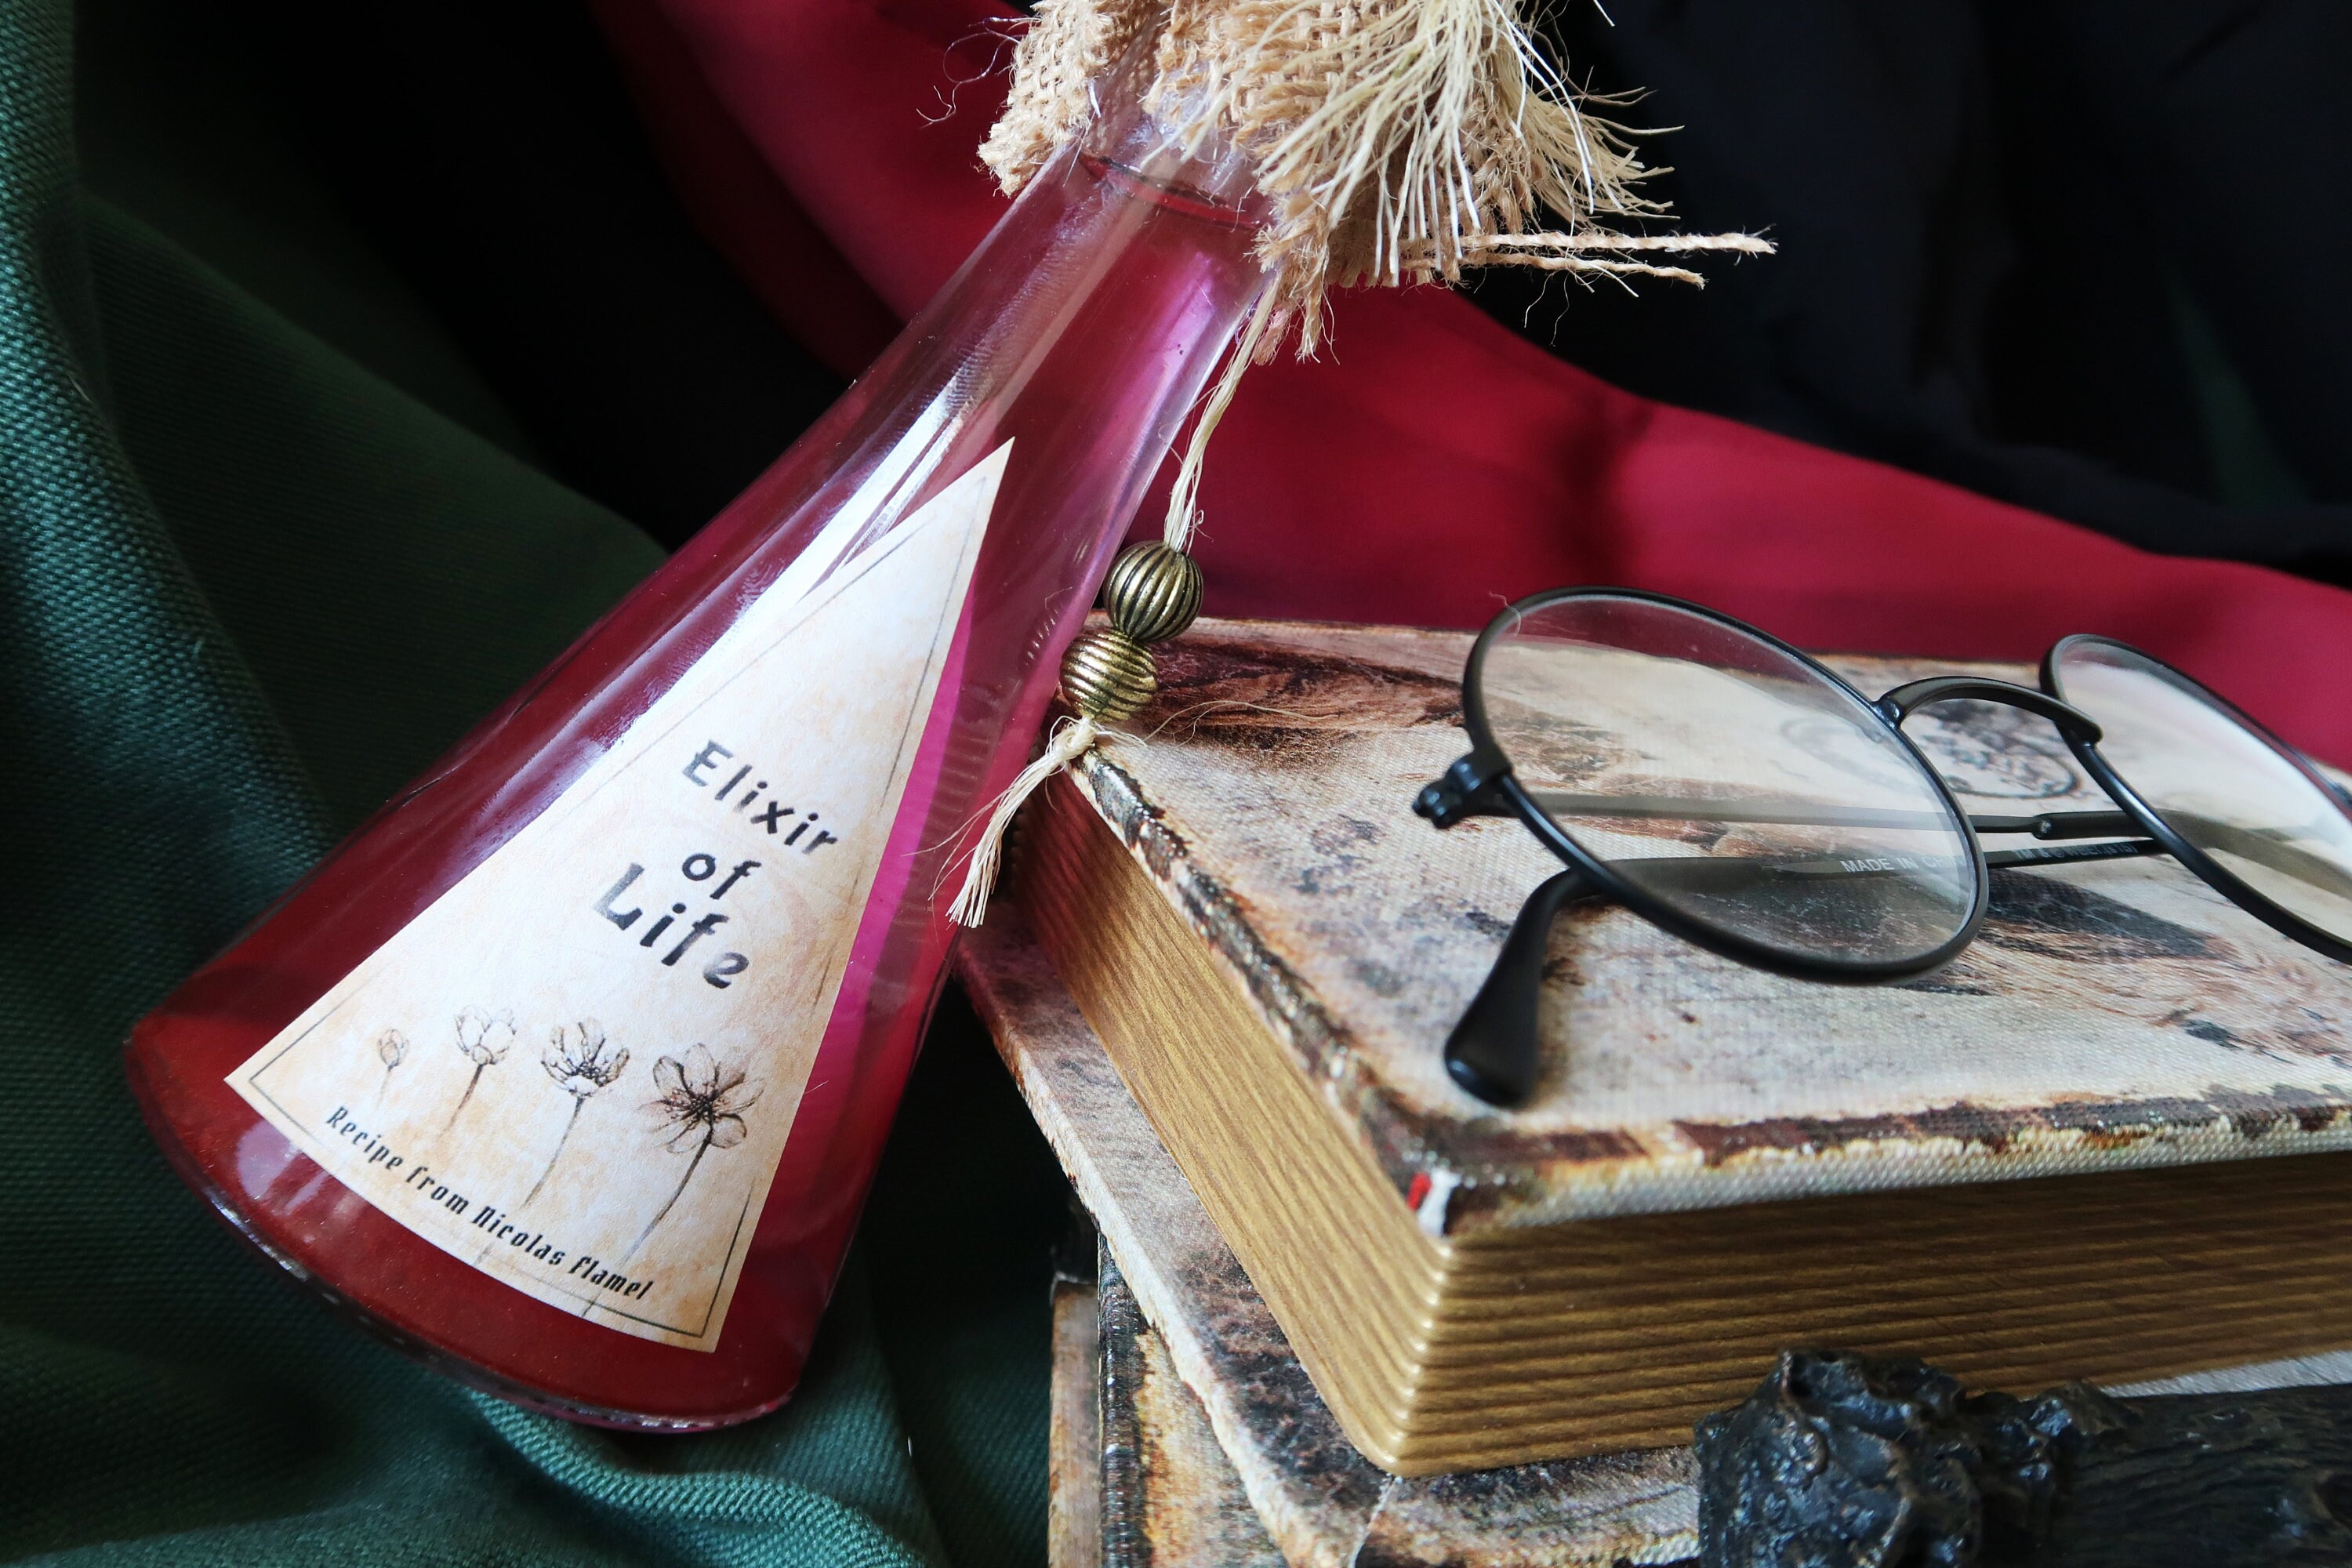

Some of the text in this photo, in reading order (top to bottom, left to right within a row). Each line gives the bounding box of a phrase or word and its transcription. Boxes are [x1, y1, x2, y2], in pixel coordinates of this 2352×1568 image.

[682, 740, 837, 855] Elixir
[682, 853, 761, 899] of
[1840, 858, 1895, 873] MADE
[1896, 857, 1919, 869] IN
[593, 863, 749, 989] Life
[326, 1106, 404, 1171] Recipe
[405, 1166, 470, 1214] from
[471, 1206, 566, 1265] Nicolas
